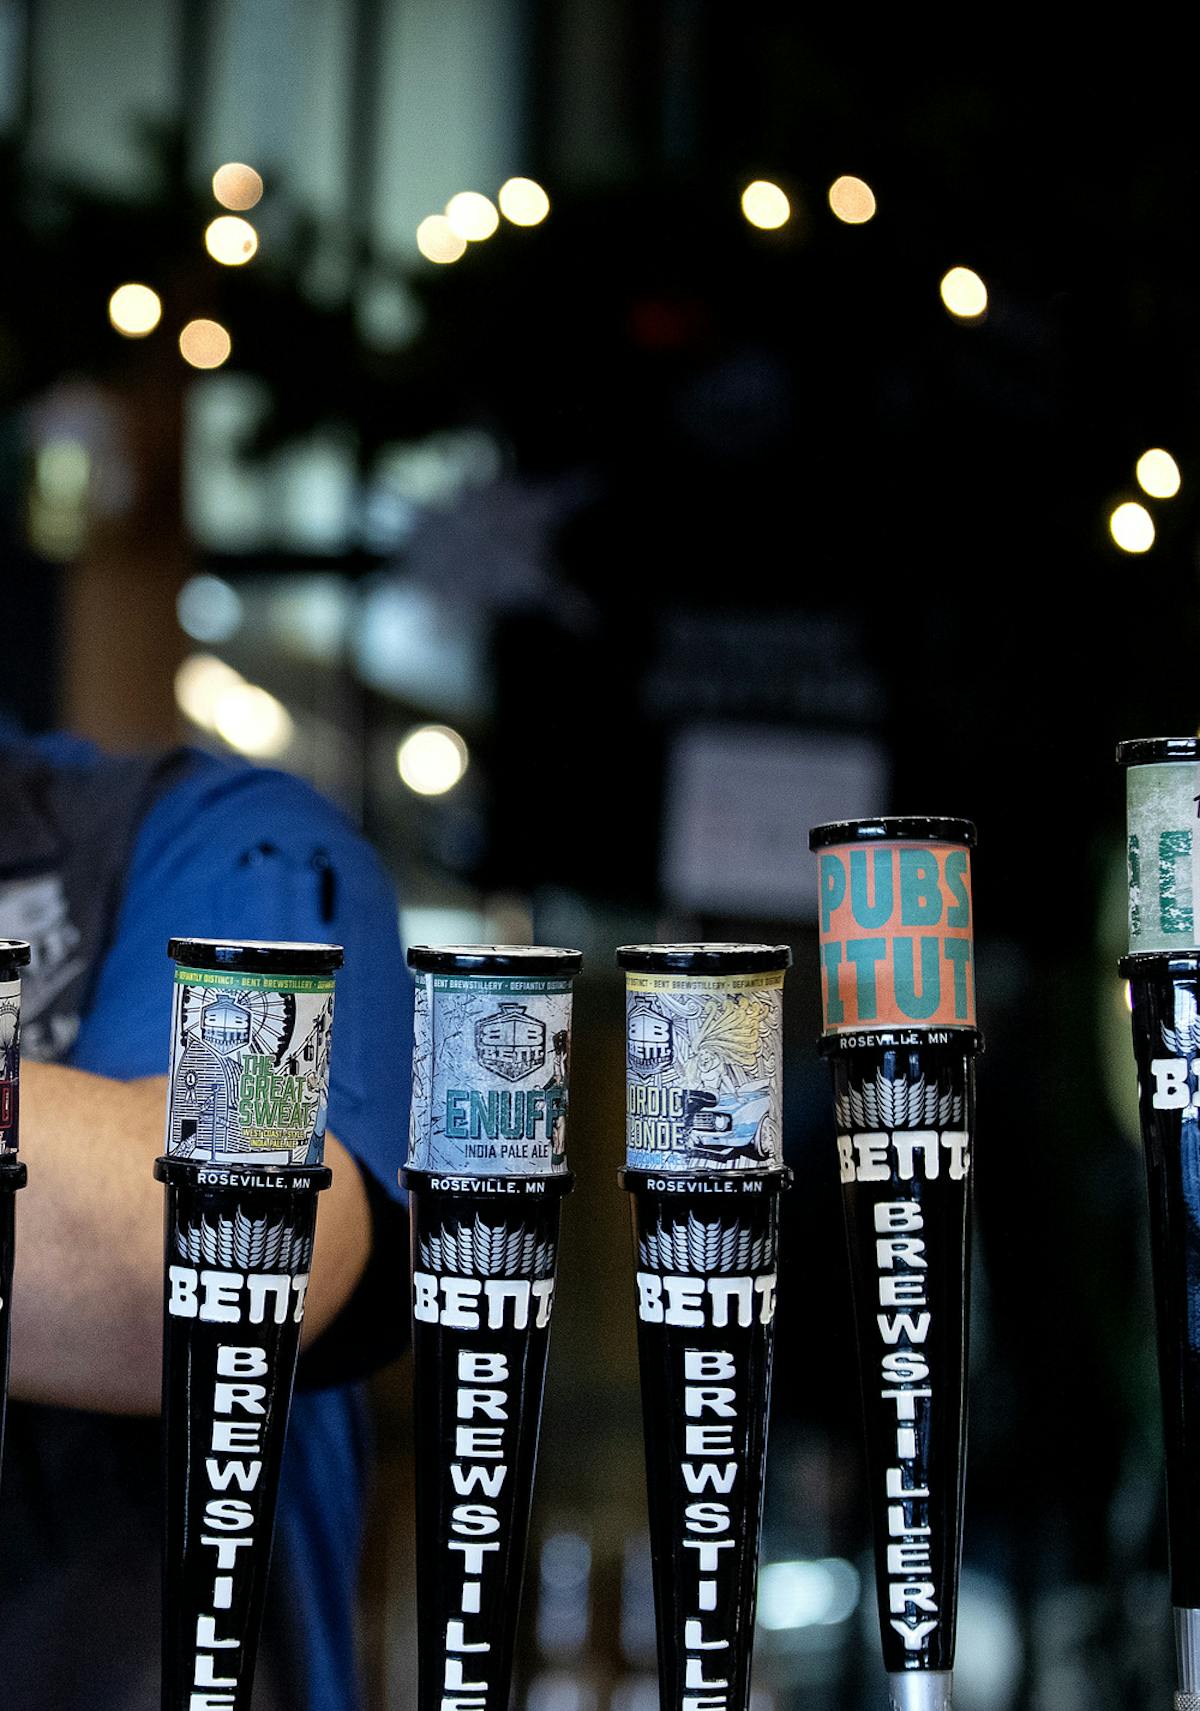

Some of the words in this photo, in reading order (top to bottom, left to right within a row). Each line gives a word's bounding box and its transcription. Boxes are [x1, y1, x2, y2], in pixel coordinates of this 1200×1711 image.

[821, 848, 969, 933] PUBS
[204, 974, 234, 985] DISTINCT
[241, 977, 260, 987] BENT
[263, 978, 312, 989] BREWSTILLERY
[434, 978, 448, 988] BENT
[450, 979, 502, 990] BREWSTILLERY
[510, 981, 545, 990] DEFIANTLY
[654, 979, 669, 988] BENT
[672, 980, 726, 990] BREWSTILLERY
[928, 1032, 948, 1045] MN
[242, 1055, 275, 1076] THE
[240, 1074, 306, 1102] GREAT
[239, 1100, 311, 1128] SWEAT
[446, 1089, 566, 1139] ENUFF
[627, 1119, 685, 1150] LONDE
[465, 1144, 496, 1158] INDIA
[501, 1144, 528, 1158] PALE
[531, 1144, 549, 1158] ALE
[838, 1130, 970, 1183] BENT
[292, 1178, 311, 1189] MN
[525, 1181, 545, 1193] MN
[742, 1181, 763, 1192] MN
[168, 1265, 310, 1324] BENT
[413, 1271, 554, 1330] BENT
[636, 1271, 777, 1327] BENT
[873, 1201, 932, 1653] BREWSTILLERY
